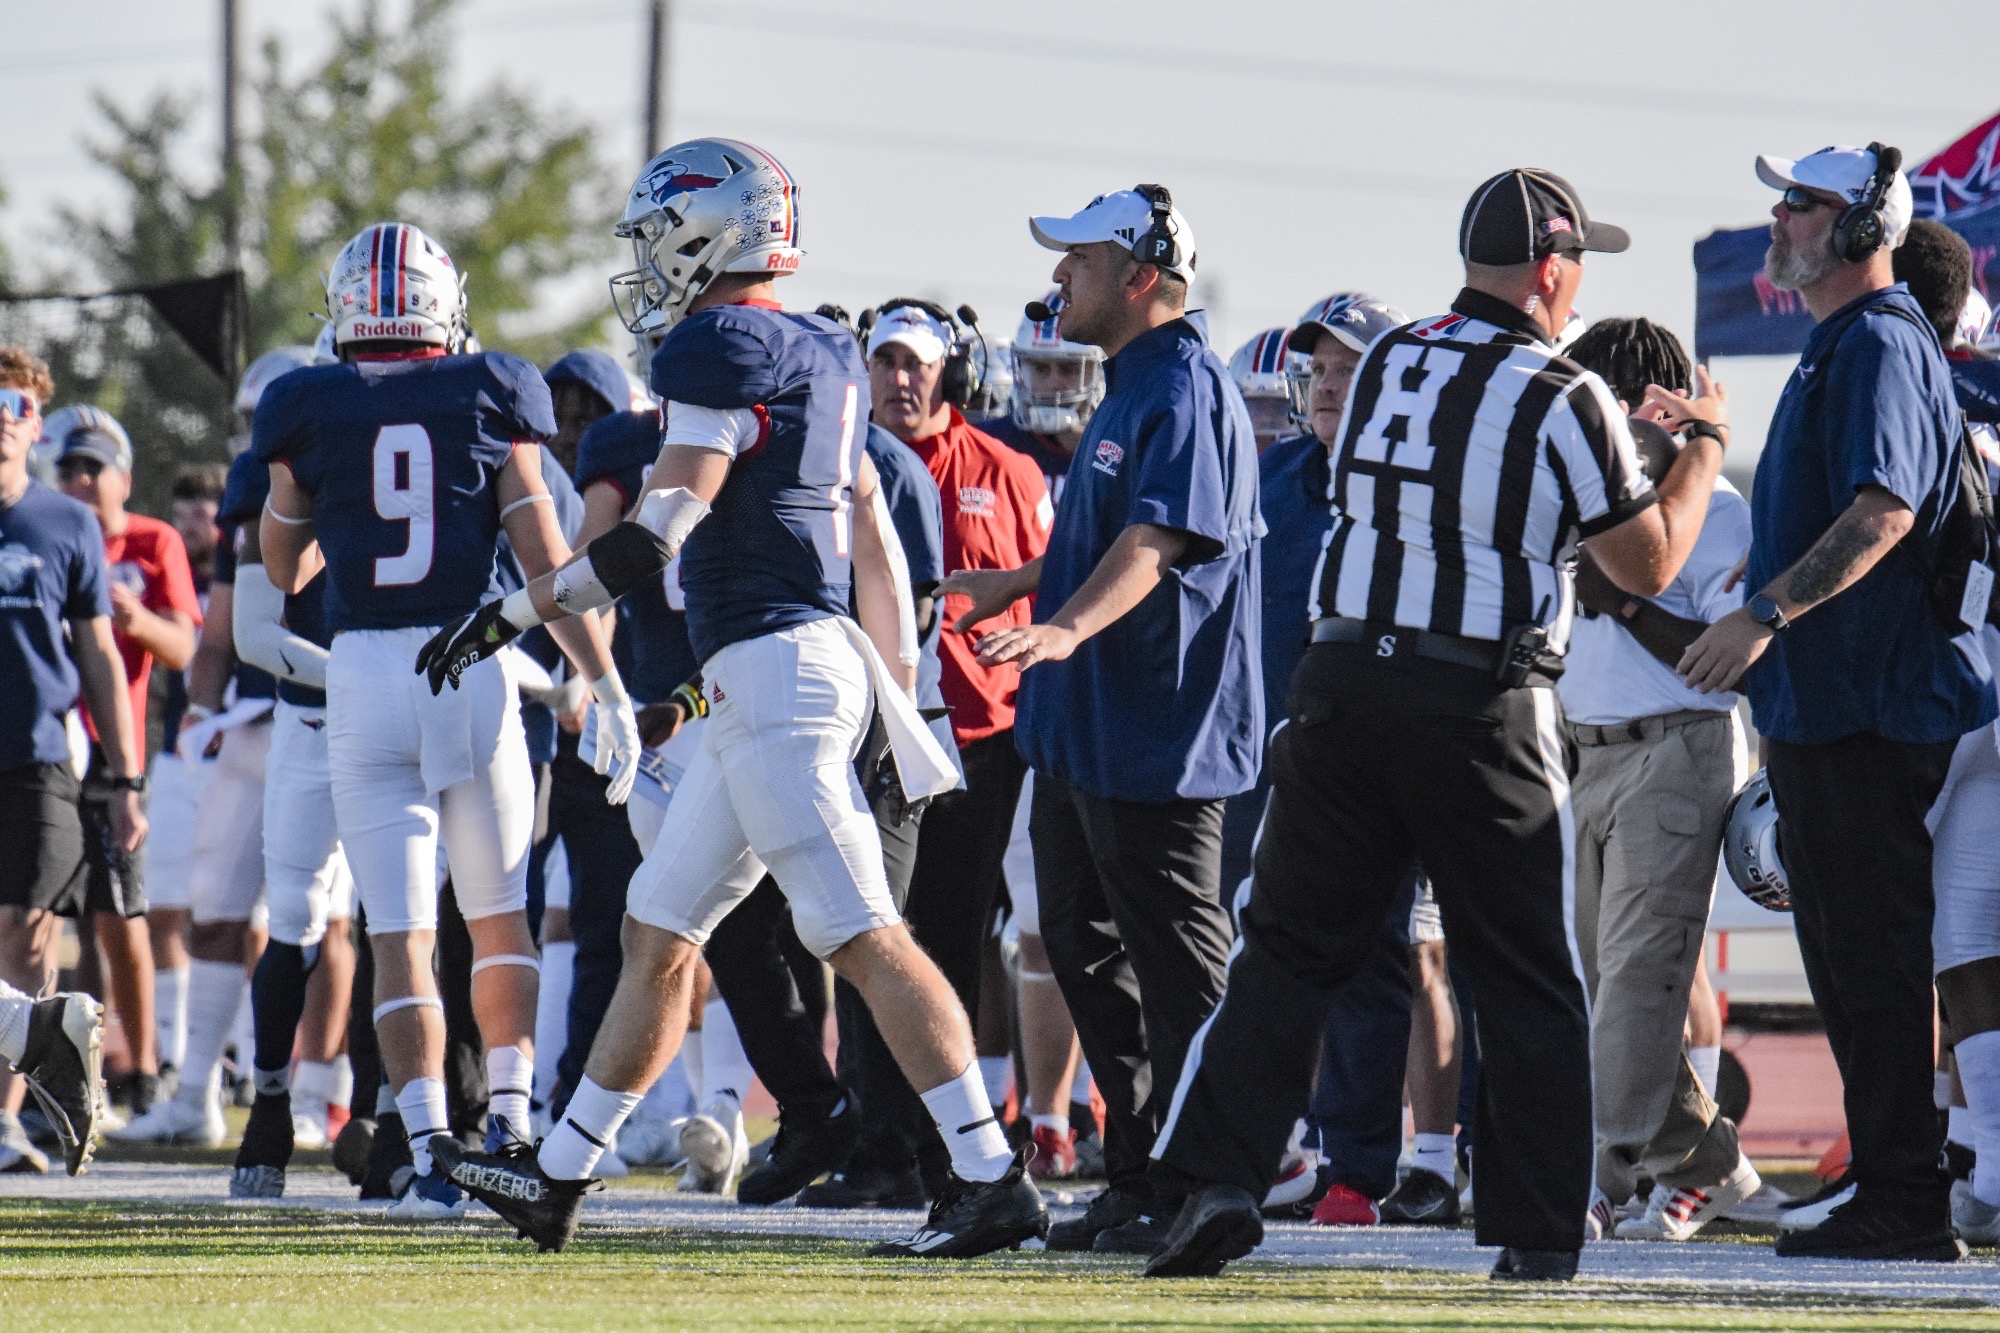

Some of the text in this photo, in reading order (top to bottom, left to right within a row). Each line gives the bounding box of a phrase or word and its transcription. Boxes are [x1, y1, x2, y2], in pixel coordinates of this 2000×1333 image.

[1154, 239, 1168, 257] P
[767, 252, 800, 269] Ridd
[353, 321, 423, 337] Riddell
[1353, 343, 1467, 472] H
[831, 383, 858, 557] 1
[372, 422, 435, 588] 9
[1376, 635, 1397, 657] S
[451, 650, 480, 677] POR
[1766, 871, 1791, 895] dell
